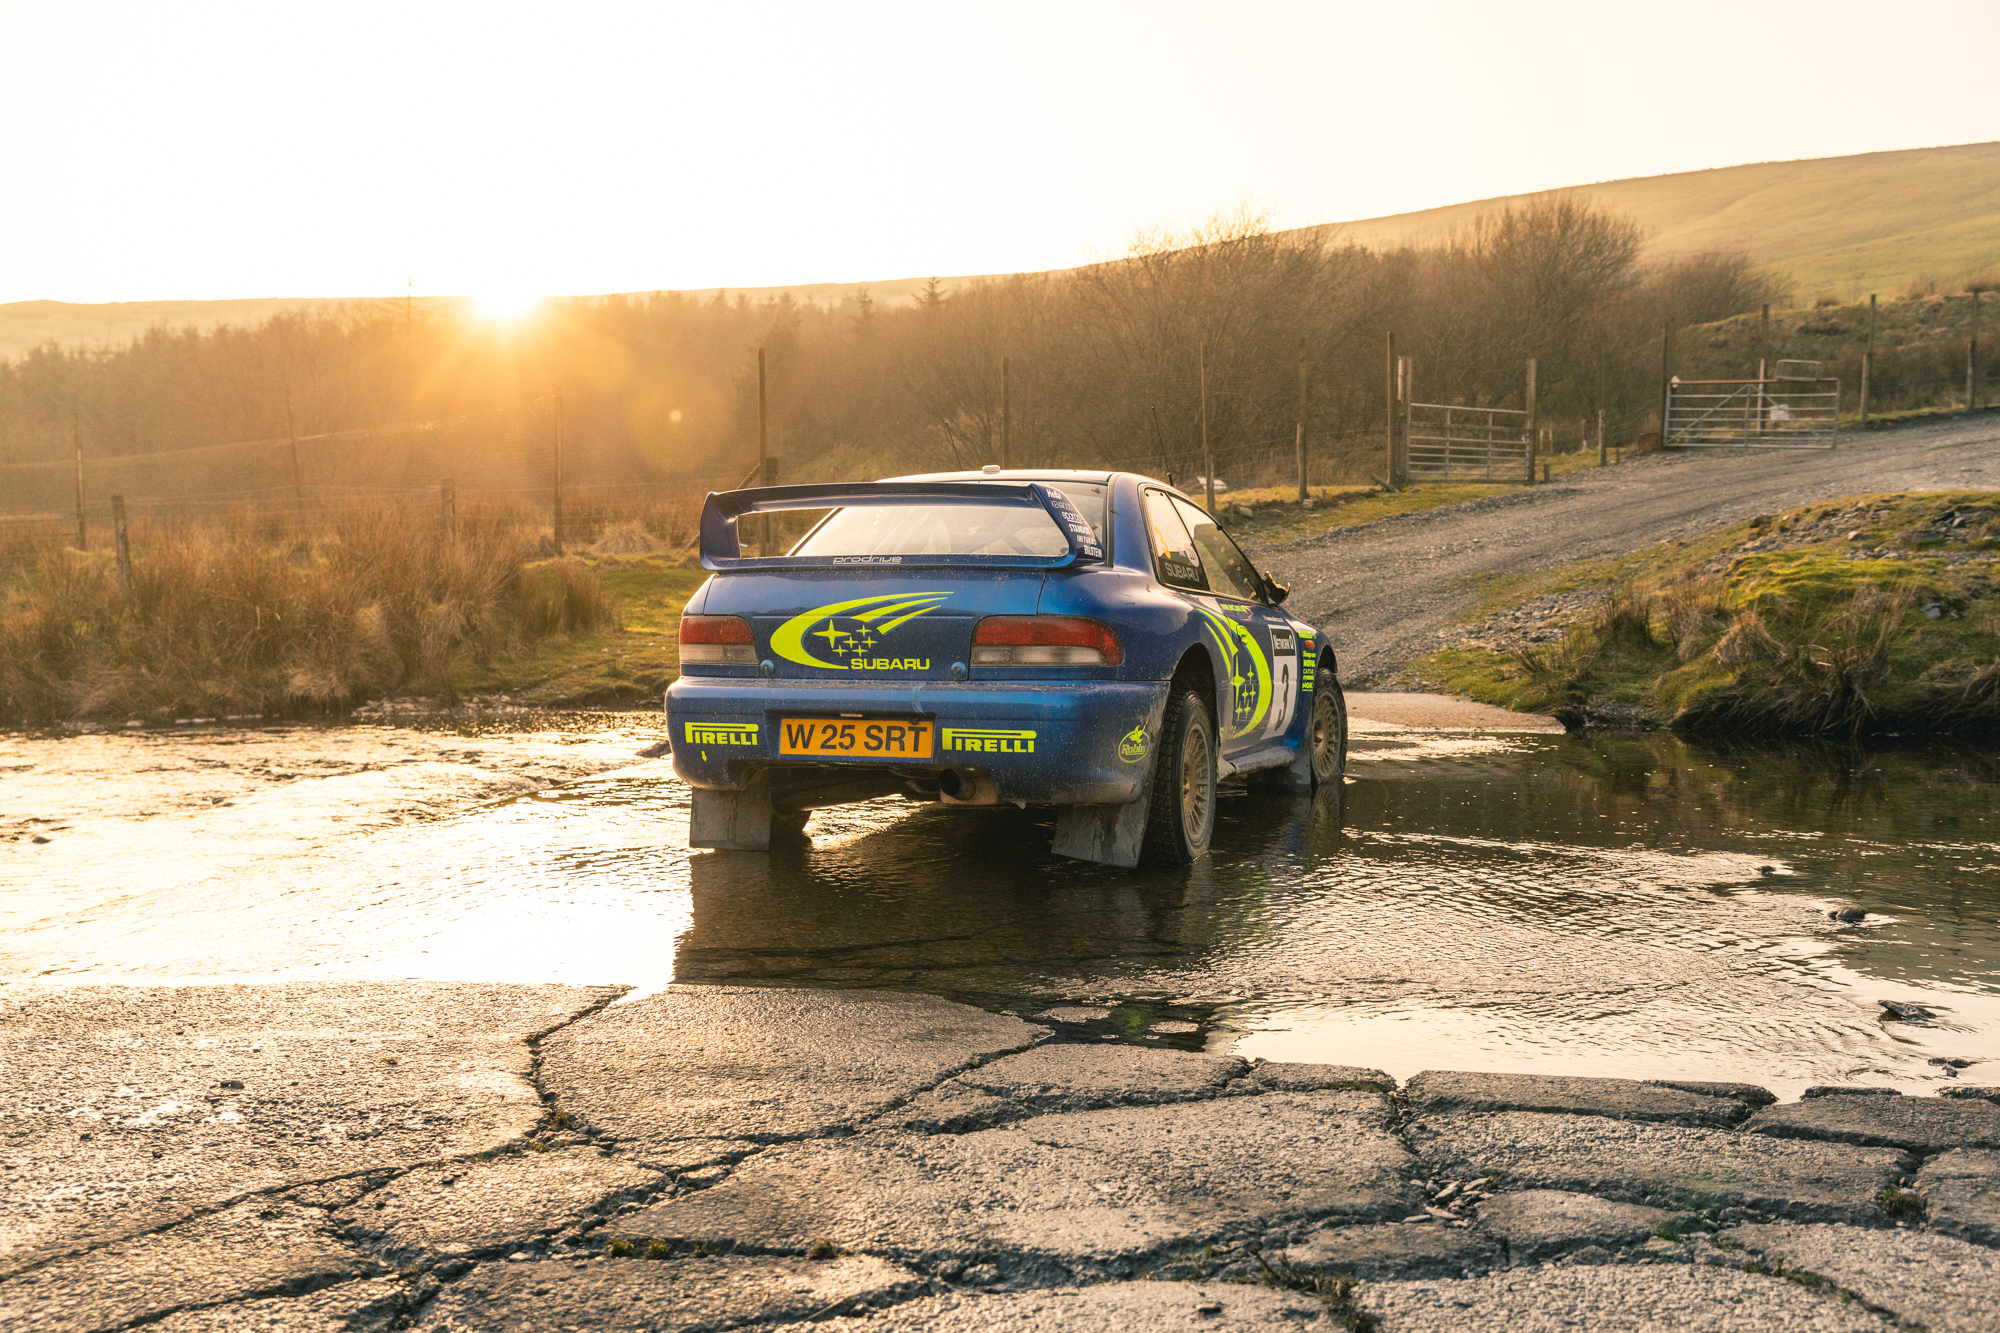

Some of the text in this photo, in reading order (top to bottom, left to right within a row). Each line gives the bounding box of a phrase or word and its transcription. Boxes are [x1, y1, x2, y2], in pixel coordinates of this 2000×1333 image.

[1046, 488, 1062, 499] Hella
[833, 555, 902, 564] prodrive
[1165, 562, 1200, 582] SUBARU
[850, 658, 931, 671] SUBARU
[1274, 663, 1289, 732] 3
[685, 722, 759, 746] PIRELLI
[786, 724, 928, 752] W 25 SRT
[942, 728, 1037, 753] PIRELLI
[1121, 743, 1146, 756] Robin
